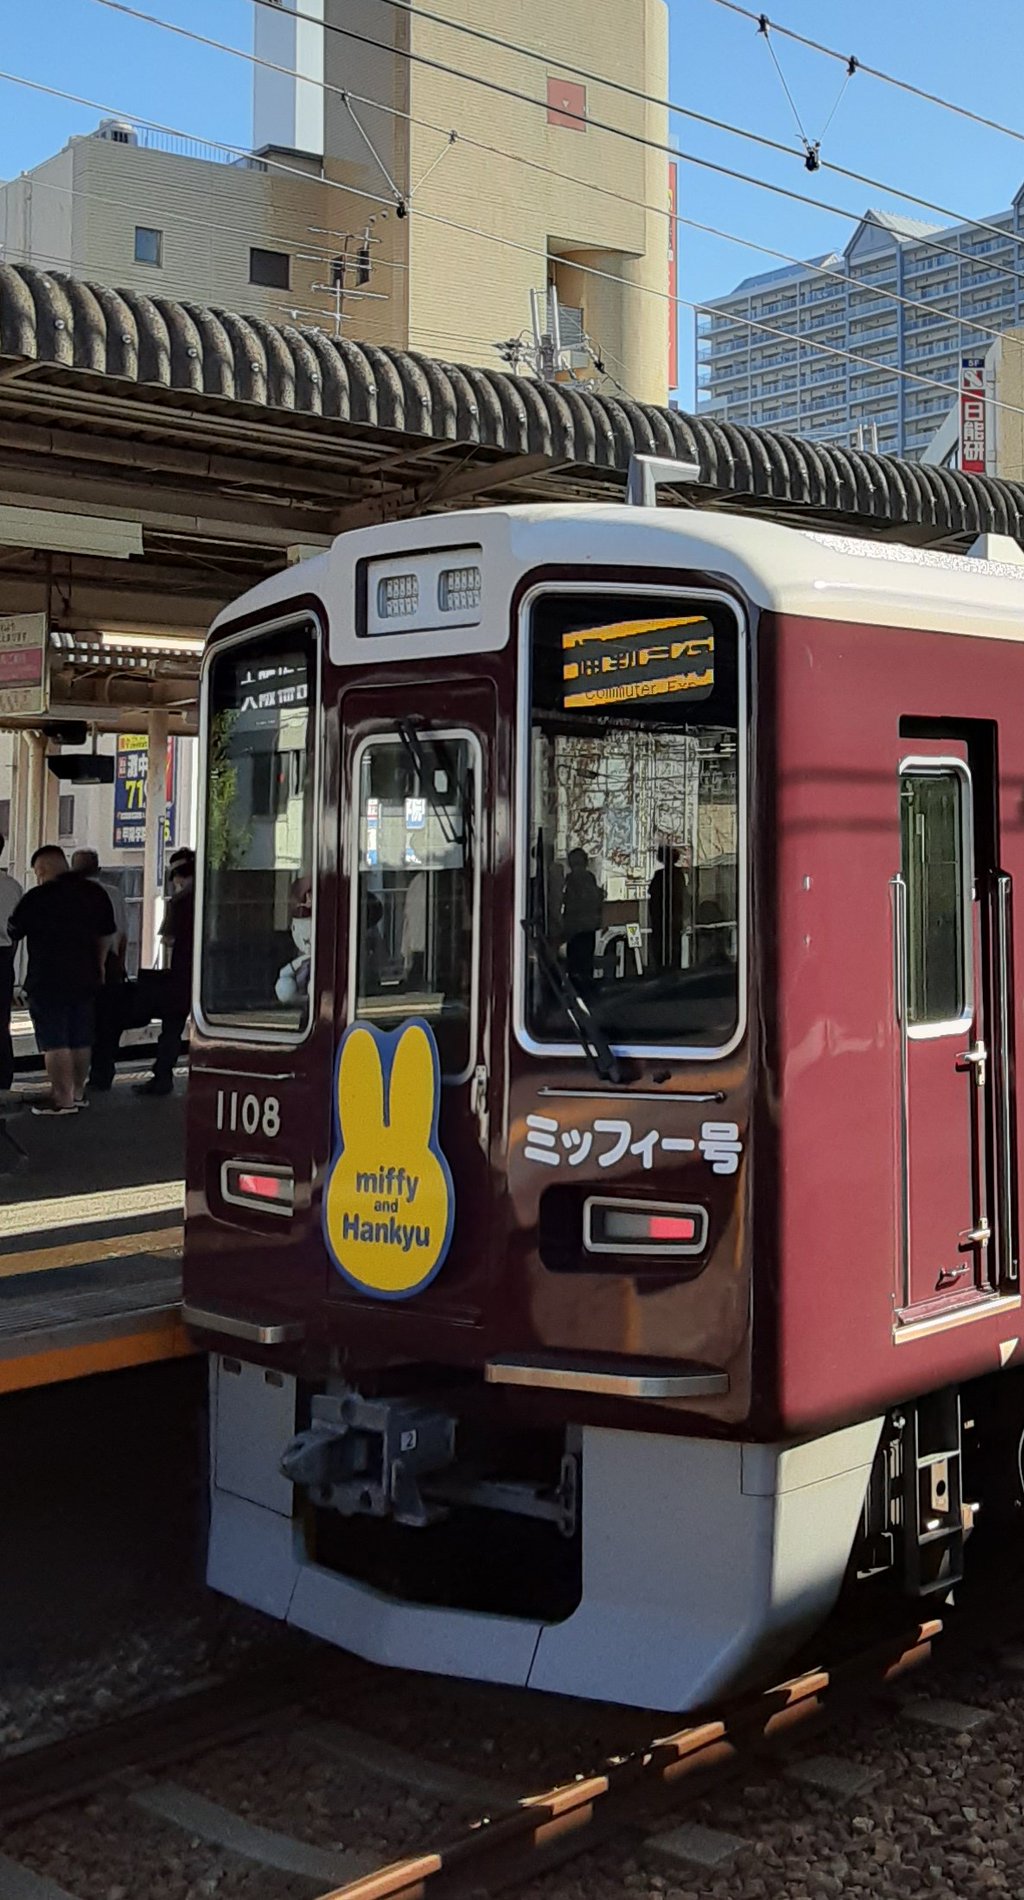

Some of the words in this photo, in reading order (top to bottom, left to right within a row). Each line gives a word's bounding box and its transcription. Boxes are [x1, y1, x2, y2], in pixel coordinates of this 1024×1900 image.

[964, 402, 984, 460] 日能研
[216, 1090, 281, 1137] 1108
[524, 1114, 743, 1175] ミッフィー号
[356, 1165, 419, 1203] miffy
[374, 1199, 398, 1213] and
[342, 1213, 430, 1252] Hankyu
